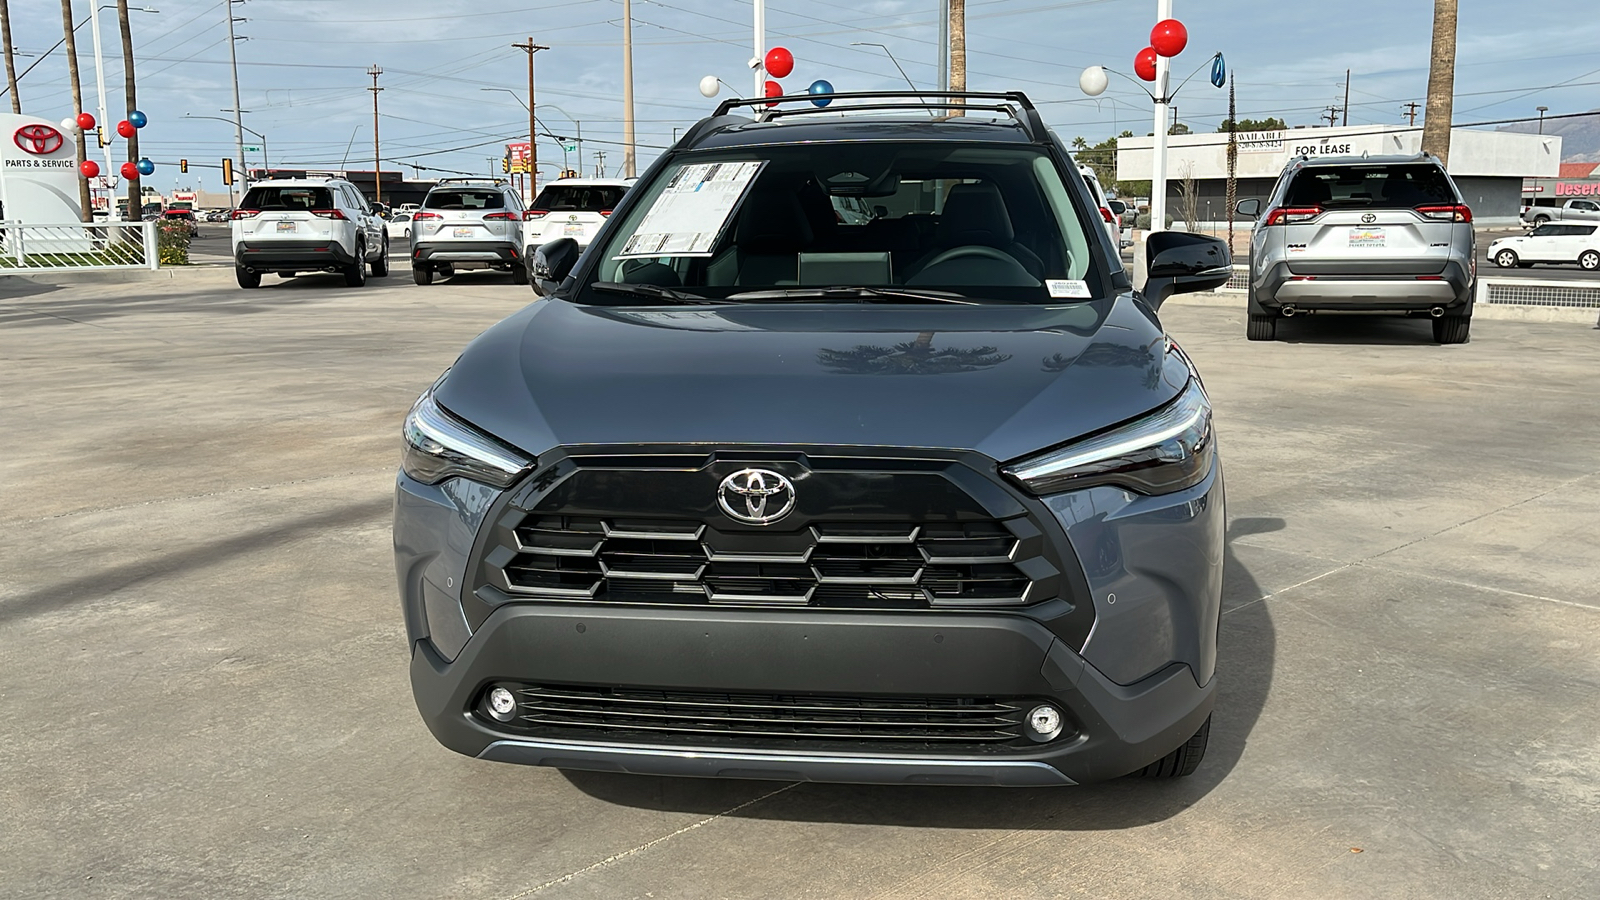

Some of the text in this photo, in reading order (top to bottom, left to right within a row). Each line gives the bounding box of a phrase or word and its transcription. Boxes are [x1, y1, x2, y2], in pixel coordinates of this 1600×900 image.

[1295, 143, 1351, 156] FOR LEASE
[5, 159, 75, 168] PARTS & SERVICE
